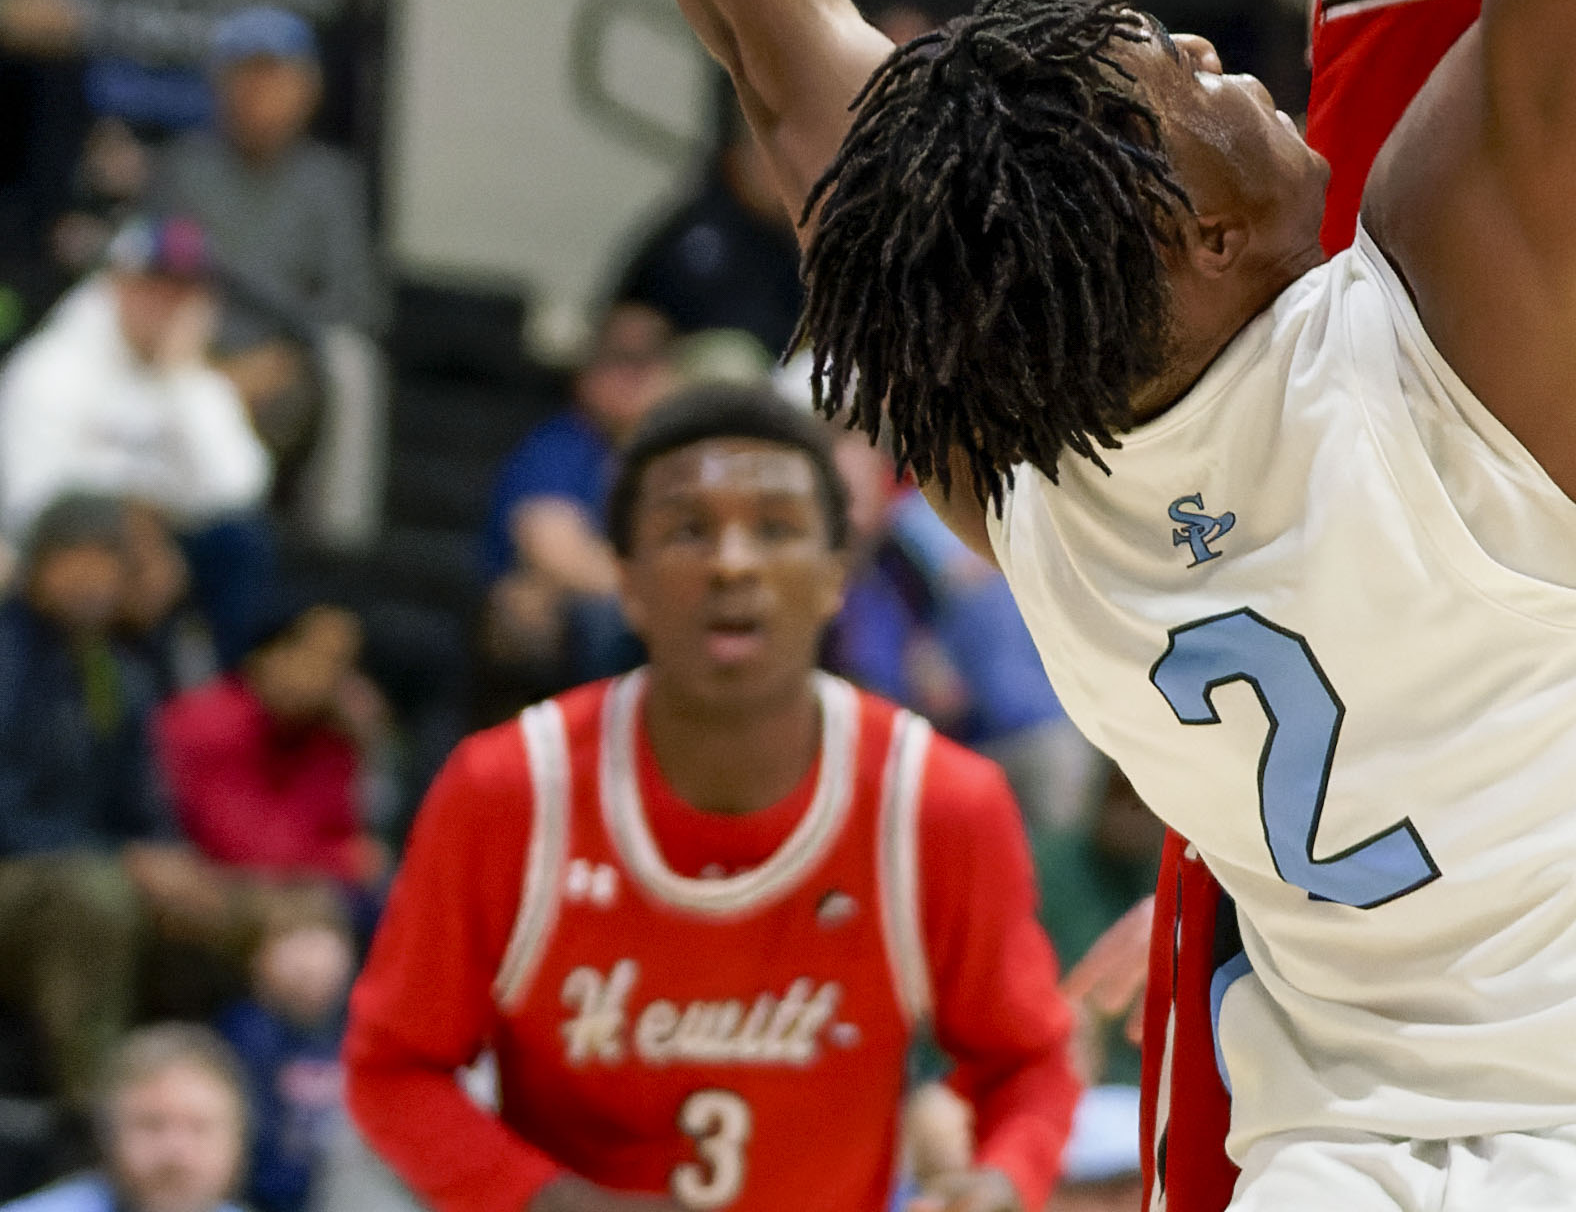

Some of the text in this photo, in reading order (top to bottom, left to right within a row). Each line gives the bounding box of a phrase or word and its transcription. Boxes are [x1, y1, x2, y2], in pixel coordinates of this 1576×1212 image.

[1149, 606, 1442, 910] 2
[561, 958, 861, 1068] Hewitt-
[671, 1089, 752, 1211] 3
